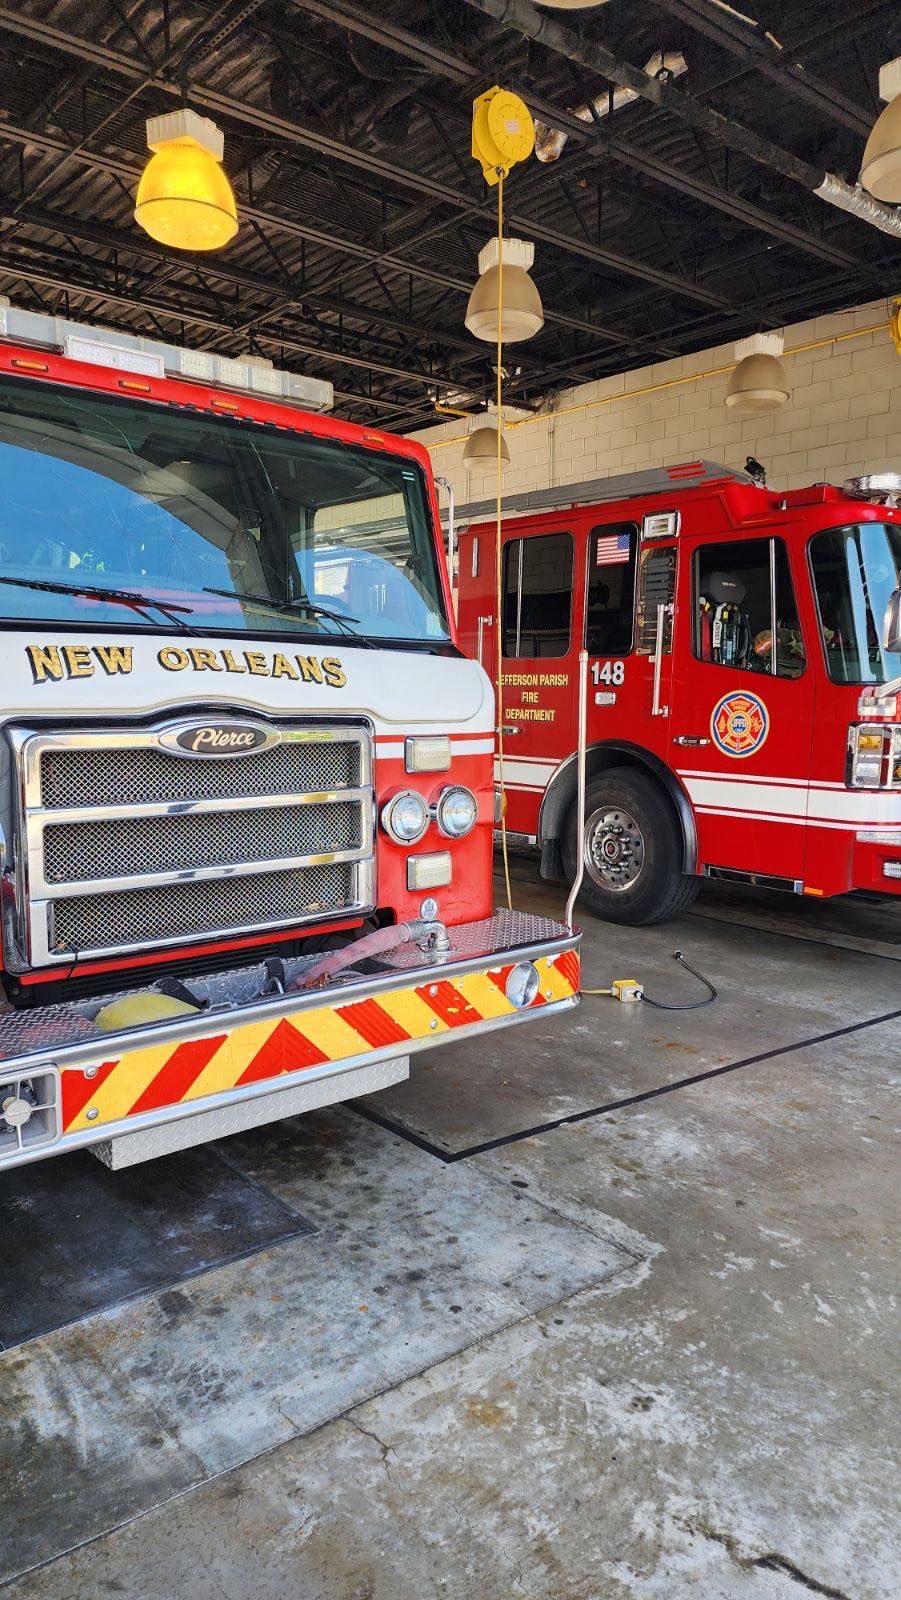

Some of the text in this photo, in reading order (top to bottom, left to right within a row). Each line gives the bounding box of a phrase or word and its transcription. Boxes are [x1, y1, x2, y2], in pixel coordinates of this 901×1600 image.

[25, 646, 347, 689] NEW ORLEANS
[591, 661, 625, 687] 148
[540, 674, 568, 687] PARISH
[522, 692, 539, 703] FIRE
[505, 708, 555, 721] DEPARTMENT
[191, 727, 256, 751] Pierce
